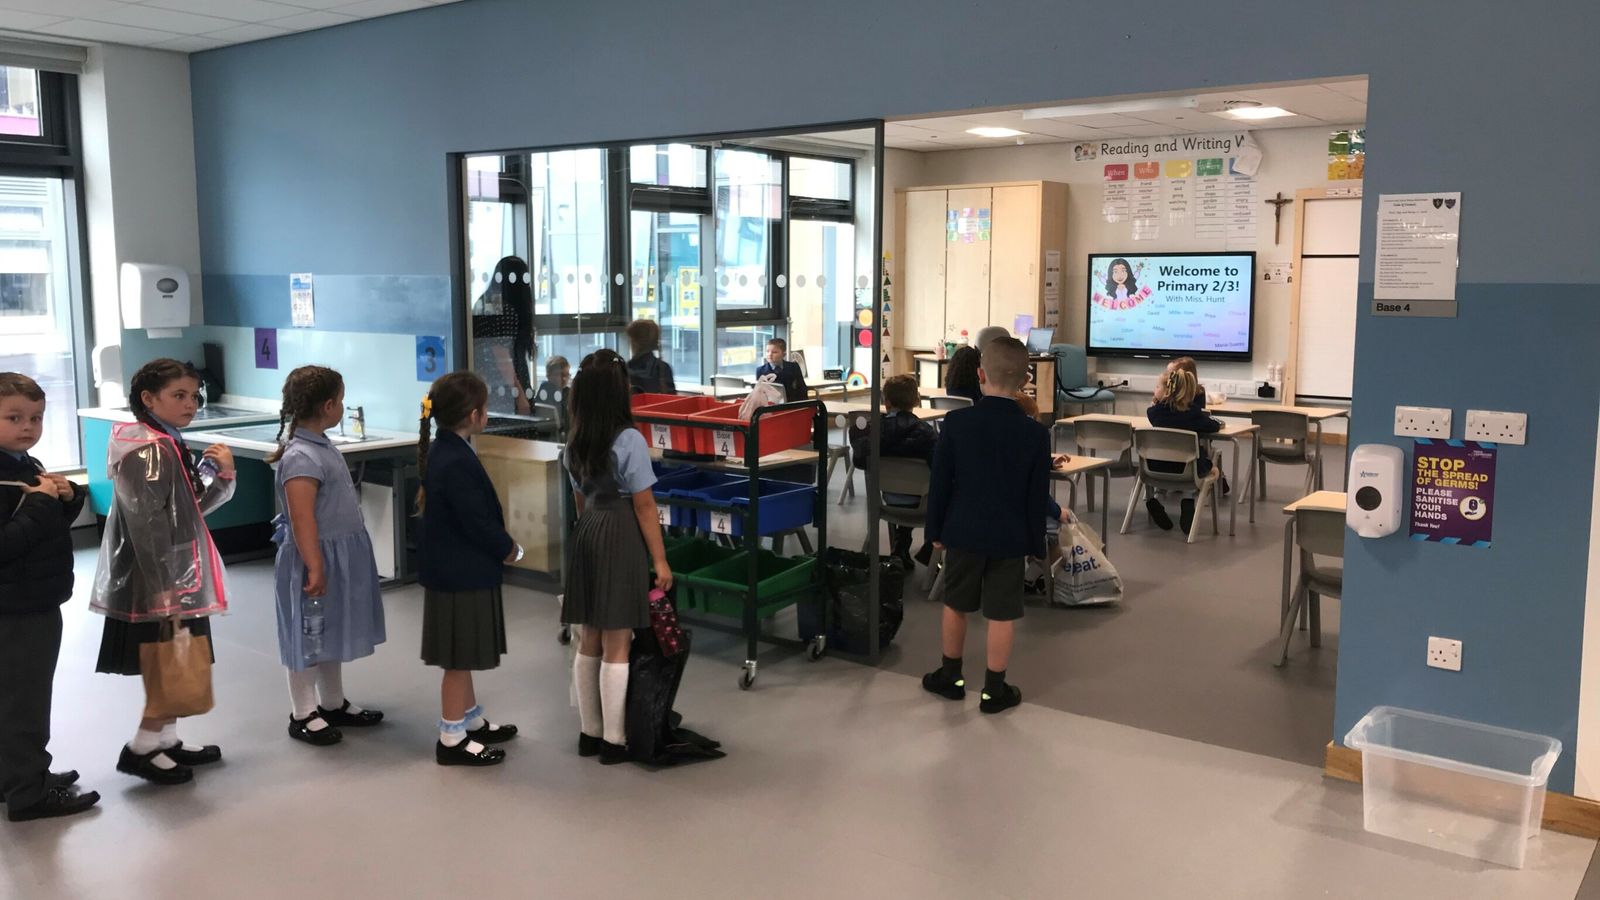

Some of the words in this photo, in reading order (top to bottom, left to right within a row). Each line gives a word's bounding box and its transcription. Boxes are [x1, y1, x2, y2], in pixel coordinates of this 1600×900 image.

[1101, 142, 1149, 158] Reading
[1155, 139, 1178, 153] and
[1182, 136, 1231, 154] Writing
[1107, 169, 1125, 177] When
[1159, 265, 1220, 277] Welcome
[1224, 266, 1238, 277] to
[1157, 281, 1208, 294] Primary
[1212, 280, 1240, 292] 2/3!
[1093, 285, 1153, 310] WELCOME
[1166, 295, 1183, 303] With
[1186, 295, 1203, 303] Miss.
[1206, 295, 1225, 303] Hunt
[1376, 303, 1401, 312] Base
[1404, 304, 1410, 312] 4
[261, 338, 271, 361] 4
[425, 346, 436, 373] 3
[658, 435, 665, 447] 4
[721, 442, 729, 456] 4
[1417, 456, 1465, 471] STOP
[1417, 469, 1438, 478] THE
[1442, 471, 1488, 482] SPREAD
[1416, 477, 1431, 485] OF
[1435, 479, 1478, 490] GERMS!
[1416, 488, 1452, 497] PLEASE
[1415, 495, 1458, 506] SANITISE
[1415, 503, 1441, 511] YOUR
[1415, 511, 1447, 520] HANDS
[717, 518, 725, 532] 4
